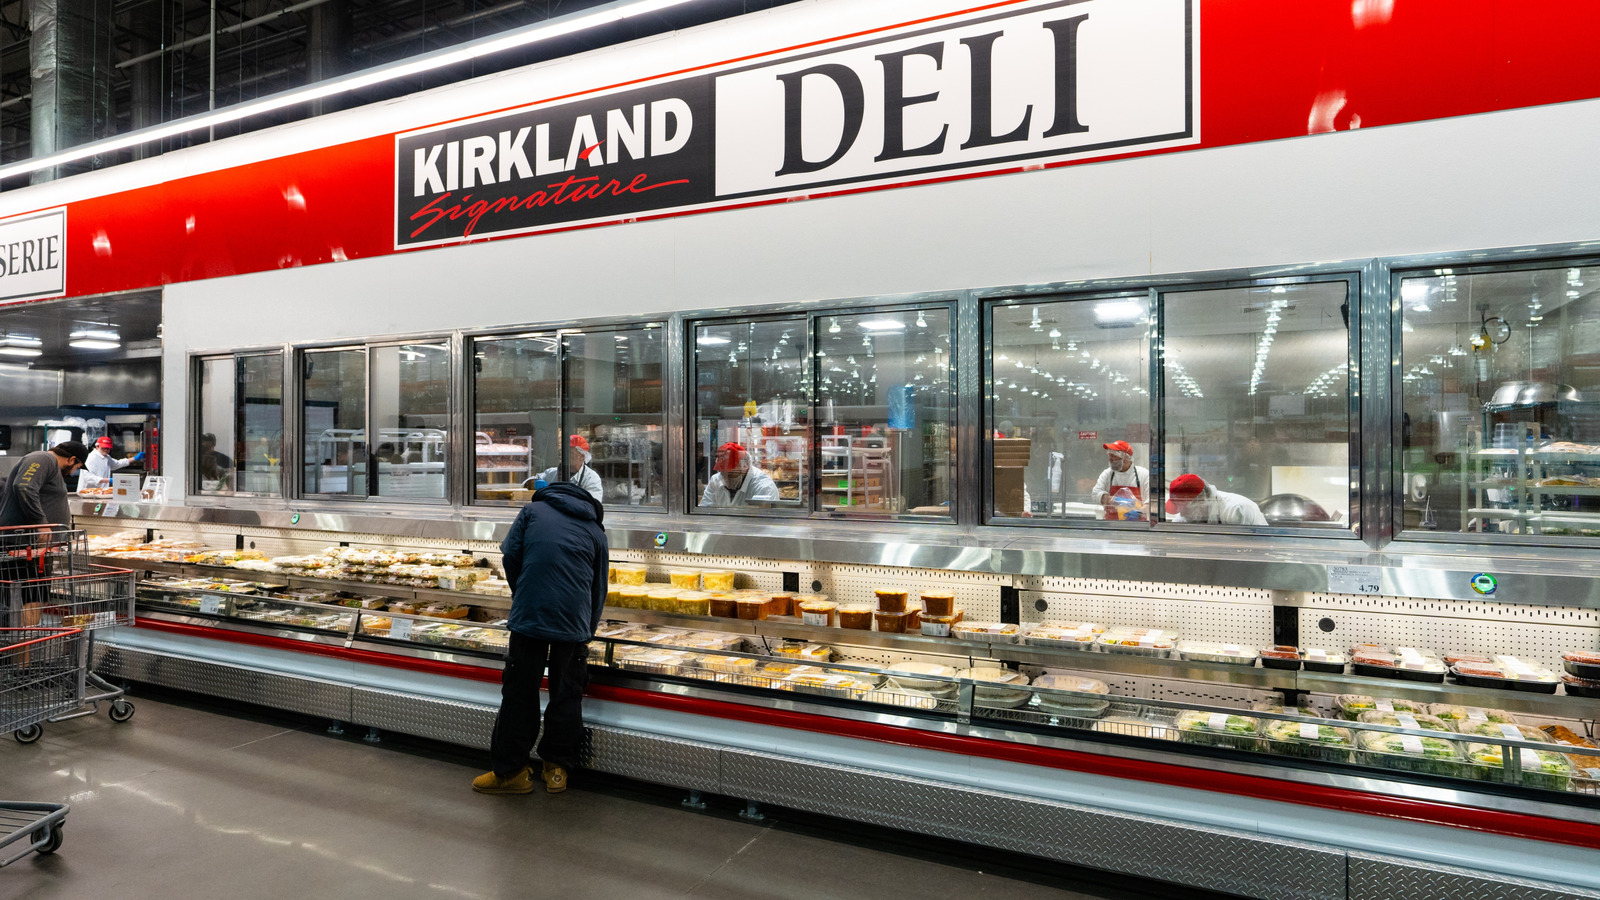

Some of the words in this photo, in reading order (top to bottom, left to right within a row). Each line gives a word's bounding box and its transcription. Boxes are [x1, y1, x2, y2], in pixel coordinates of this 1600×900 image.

[775, 13, 1089, 177] DELI
[414, 98, 693, 197] KIRKLAND
[410, 173, 689, 238] Signature
[22, 462, 40, 481] SALT
[1359, 584, 1379, 593] 4.79
